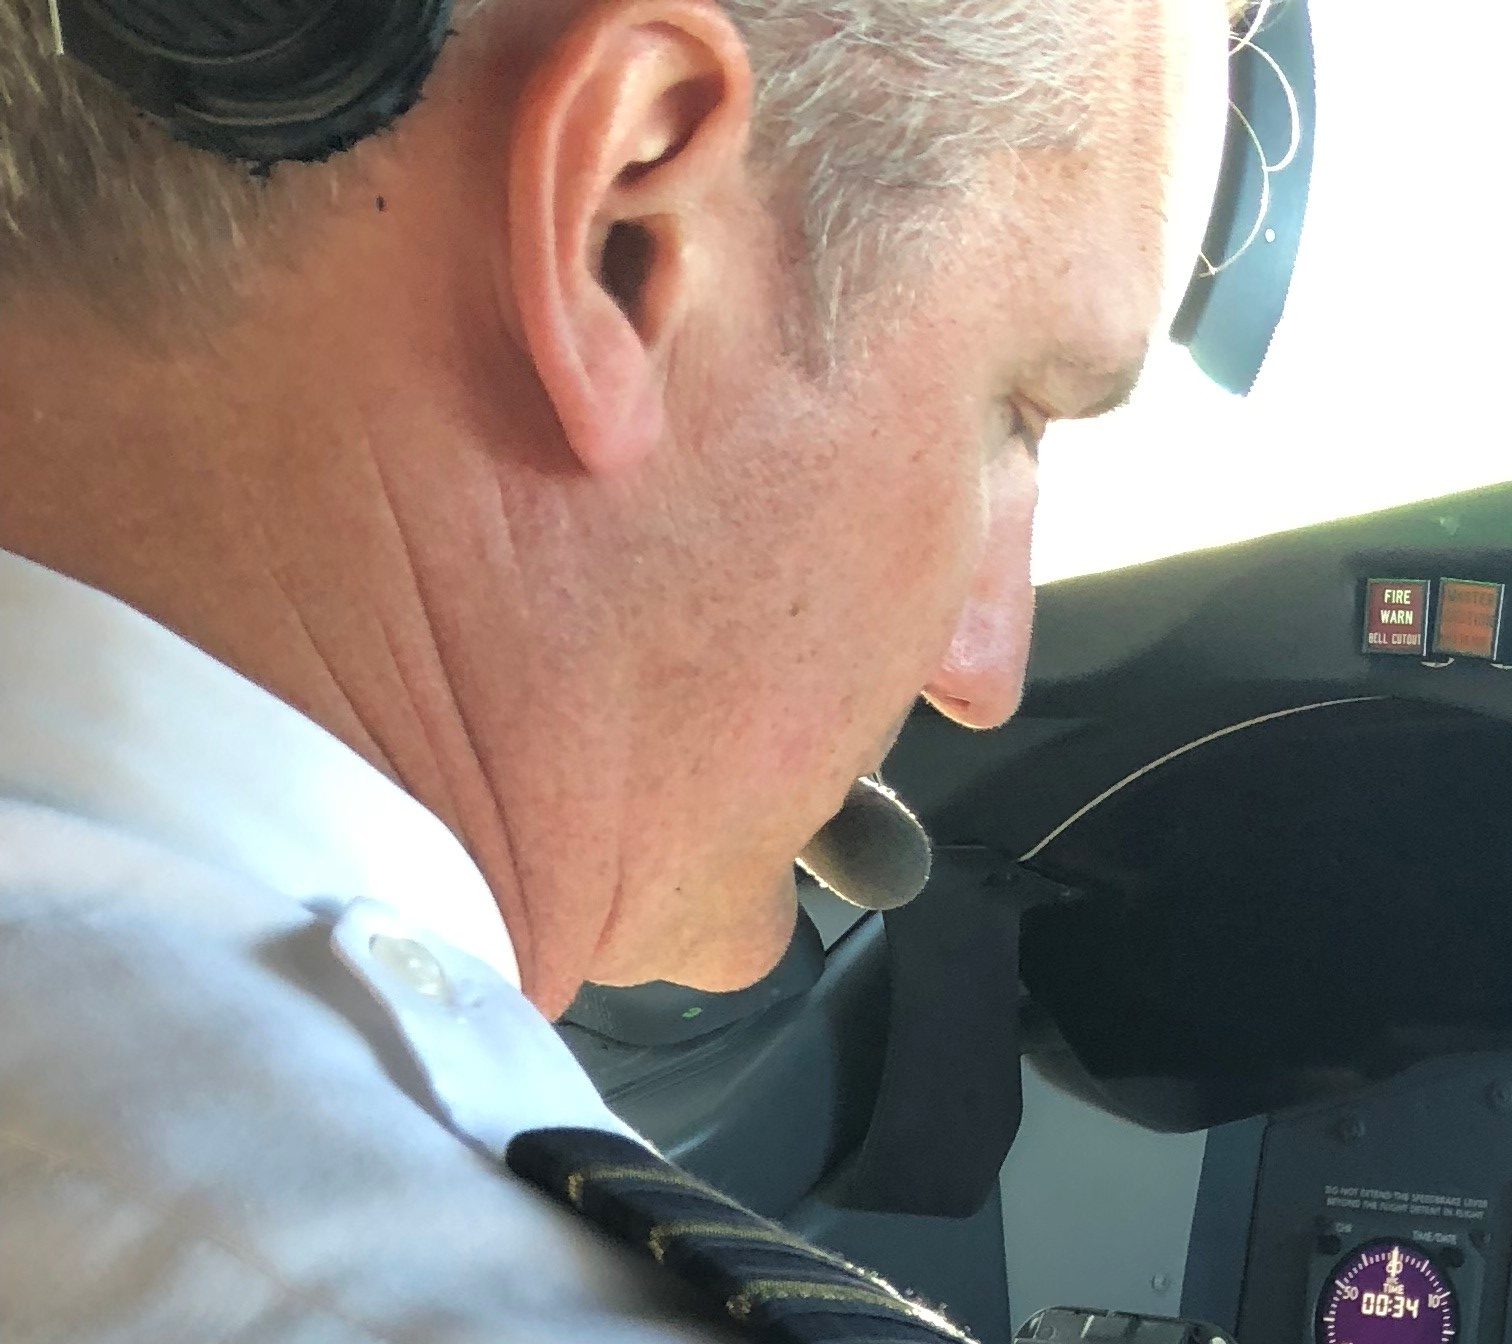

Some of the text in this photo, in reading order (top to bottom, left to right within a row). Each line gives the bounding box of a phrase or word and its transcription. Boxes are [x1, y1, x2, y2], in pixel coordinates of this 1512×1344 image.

[1384, 589, 1411, 605] FIRE
[1380, 610, 1413, 625] WARN
[1368, 633, 1388, 645] BELL
[1361, 1293, 1419, 1319] 00:34
